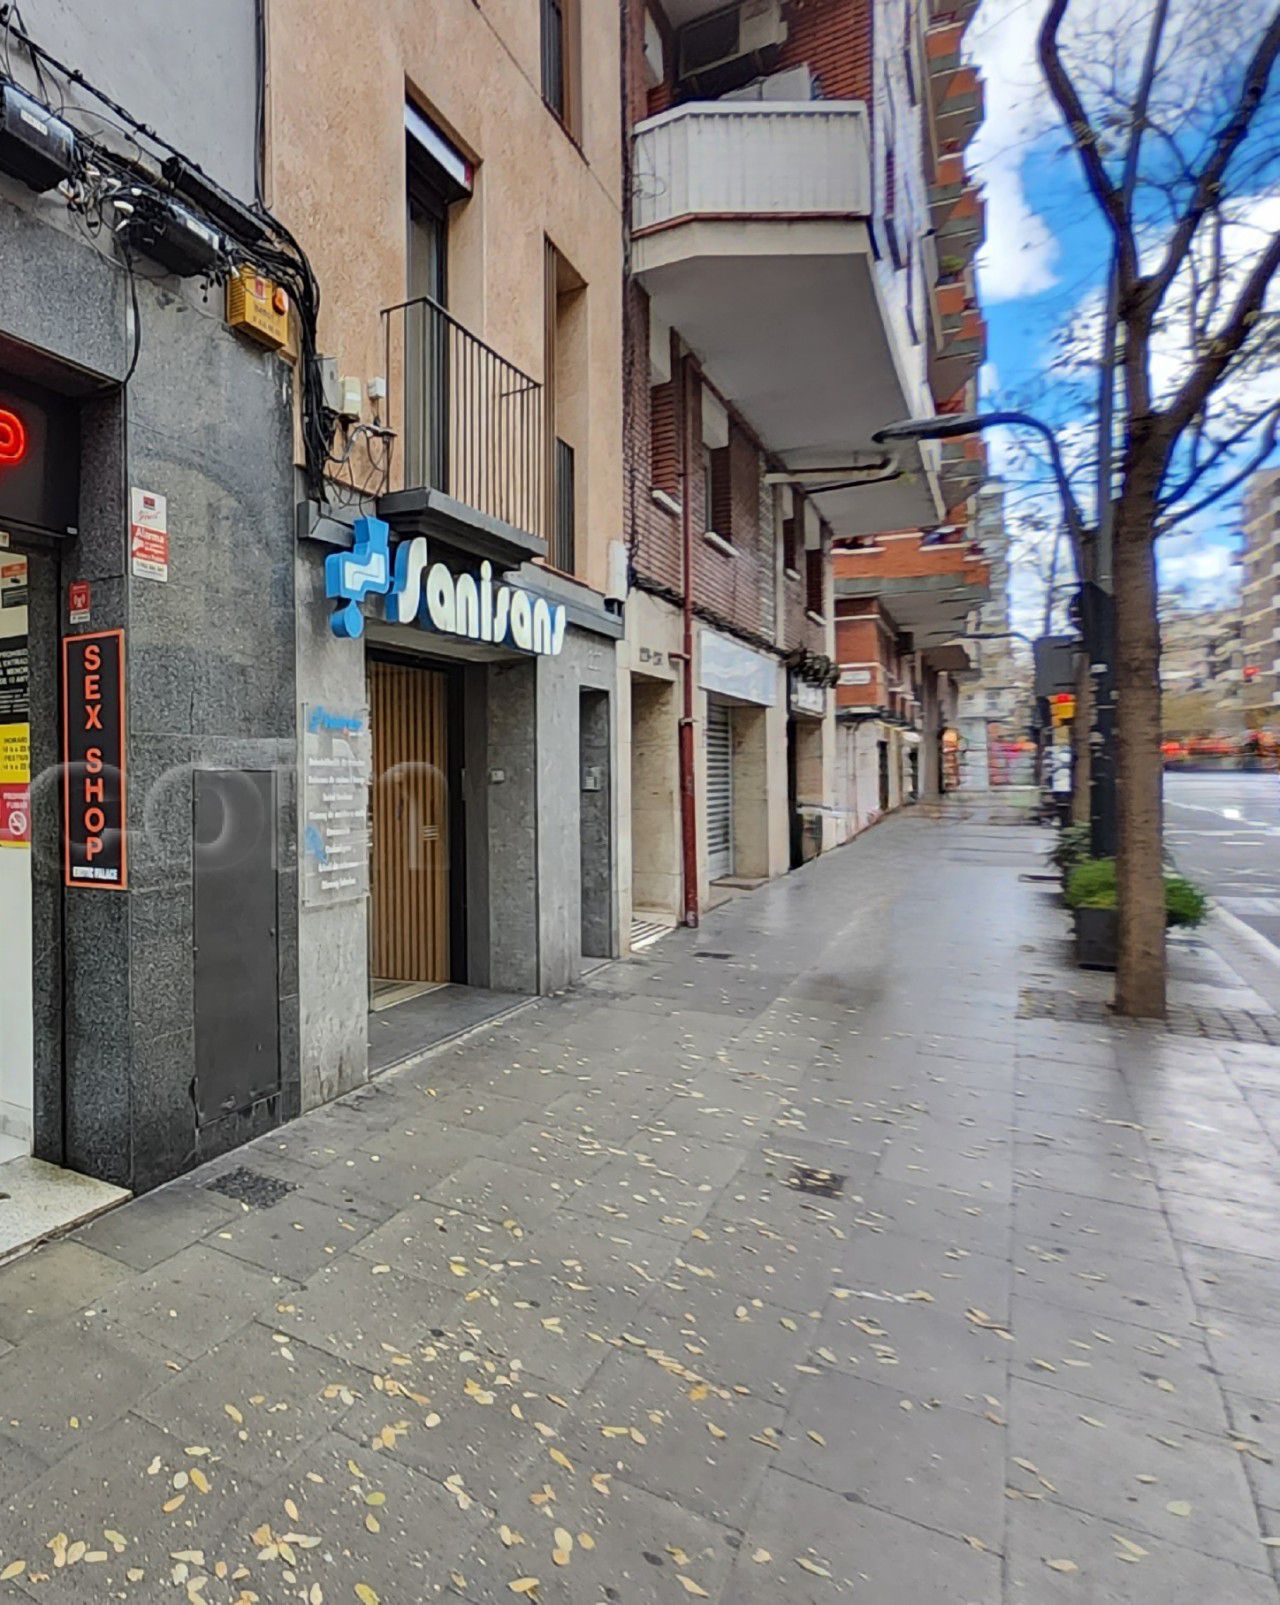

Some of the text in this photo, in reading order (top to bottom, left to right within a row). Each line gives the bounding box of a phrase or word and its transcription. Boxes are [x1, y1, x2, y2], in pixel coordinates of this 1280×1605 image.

[390, 536, 568, 656] Sanisans
[83, 644, 106, 861] SEX SHOP
